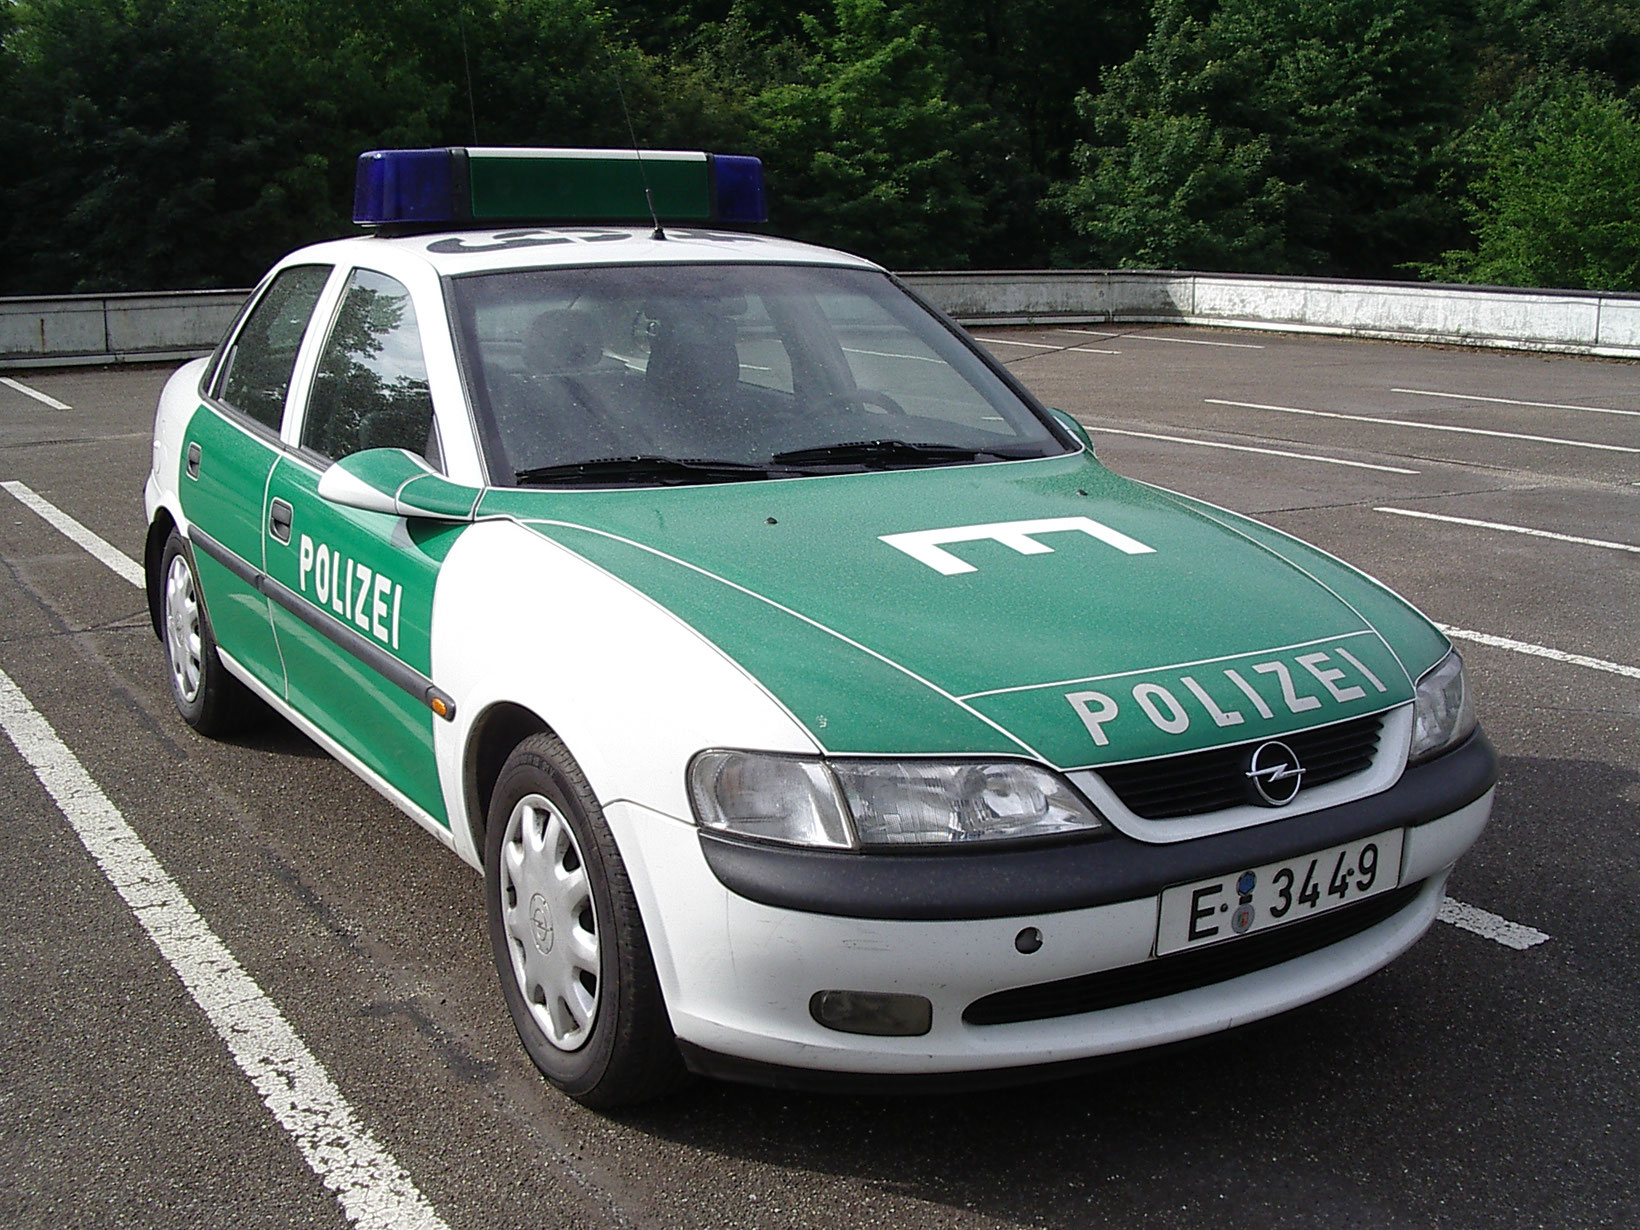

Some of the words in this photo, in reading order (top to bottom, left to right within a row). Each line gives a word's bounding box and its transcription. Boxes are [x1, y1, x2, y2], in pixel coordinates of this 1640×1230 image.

[299, 534, 402, 650] POLIZEI
[877, 516, 1157, 576] E
[1064, 648, 1387, 746] POLIZEI
[1188, 884, 1223, 942] E
[1270, 843, 1379, 918] 3449
